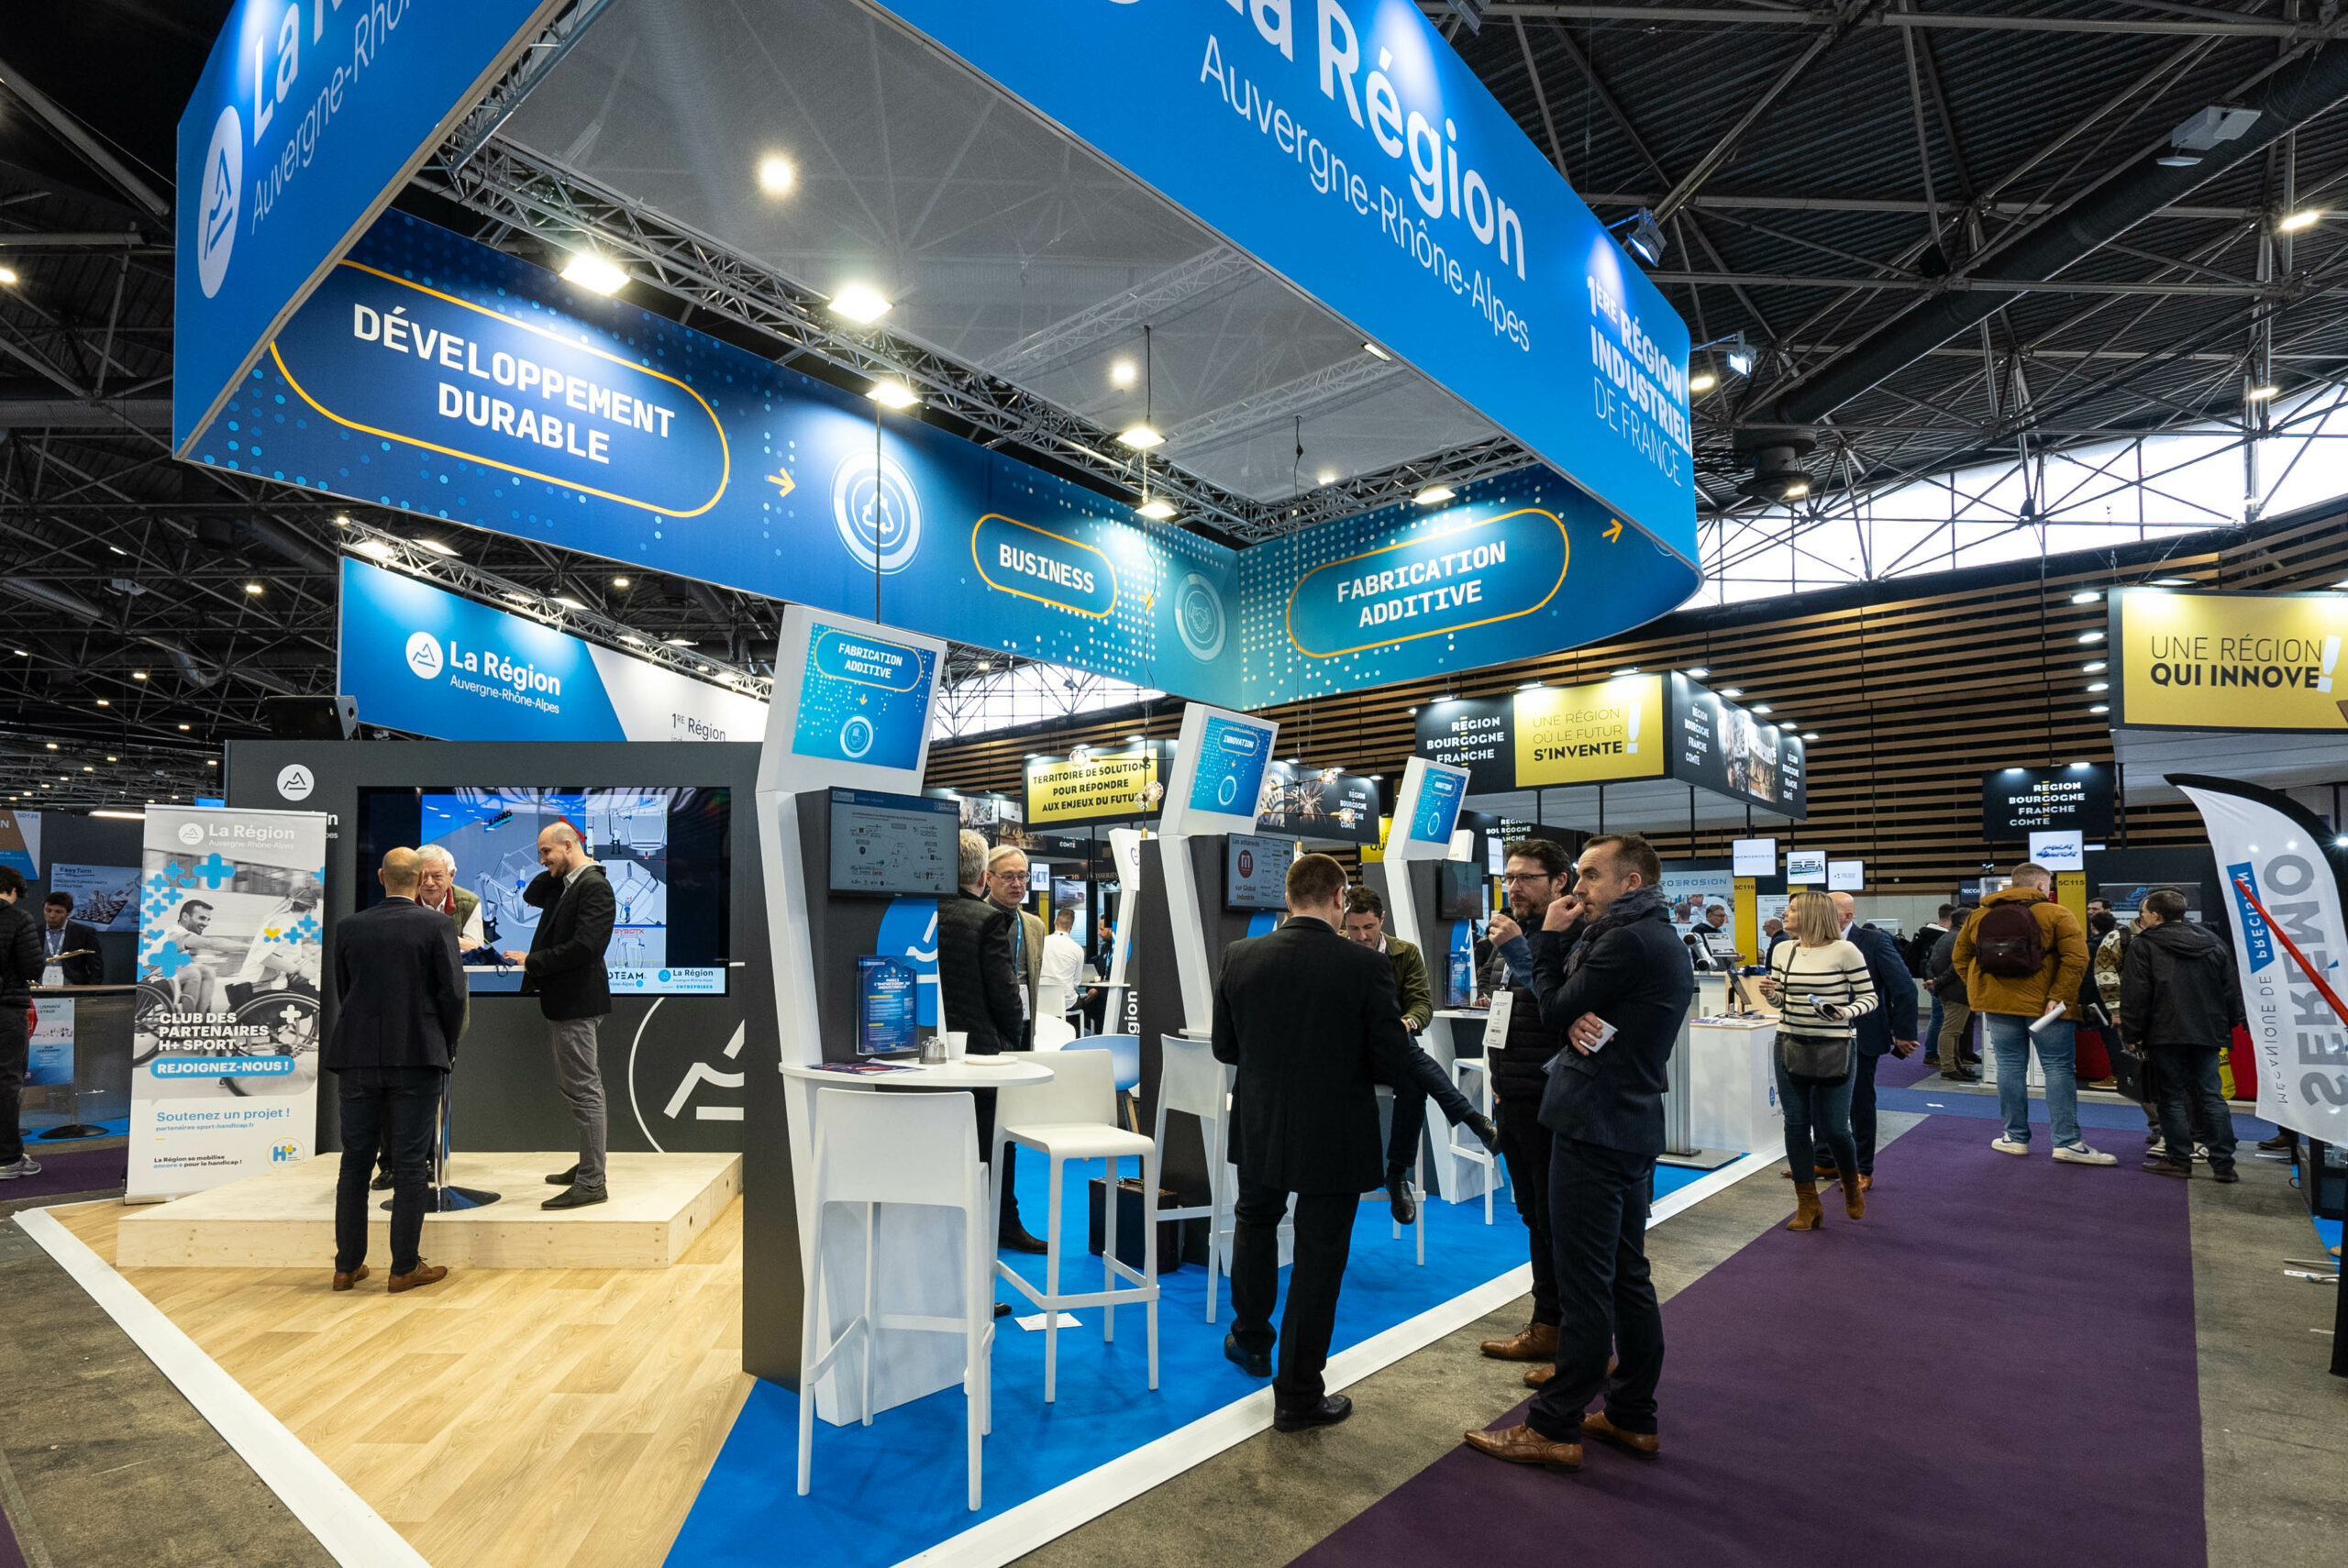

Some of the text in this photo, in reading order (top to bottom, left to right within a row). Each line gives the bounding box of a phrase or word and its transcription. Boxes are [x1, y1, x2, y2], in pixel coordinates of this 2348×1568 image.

[254, 2, 299, 148] La
[251, 0, 410, 235] Auvergne-Rhô
[1225, 0, 1526, 281] a Région
[1200, 34, 1531, 353] Auvergne-Rhône-Alpes
[1620, 308, 1683, 406] RÉGION
[353, 304, 675, 437] DÉVELOPPEMENT
[437, 382, 610, 464] DURABLE
[1594, 376, 1682, 487] DE FRANCE
[999, 543, 1095, 593] BUSINESS
[1336, 540, 1507, 602] FABRICATION
[1358, 580, 1483, 628] ADDITIVE
[838, 643, 903, 667] FABRICATION
[2151, 635, 2321, 662] UNE RÉGION
[449, 641, 560, 696] La Région
[845, 659, 892, 679] ADDITIVE
[2151, 663, 2202, 688] QUI
[2210, 665, 2320, 689] INNOVE
[449, 675, 559, 714] Auvergne-Rhône-Alpes
[1533, 707, 1620, 728] UNE RÉGION
[1684, 718, 1710, 738] BOURGOGNE
[688, 717, 726, 742] Région
[1534, 725, 1623, 744] OÙ LE FUTUR
[1223, 734, 1255, 748] INNOVATION
[1426, 731, 1505, 750] BOURGOGNE
[1688, 736, 1708, 753] FRANCHE
[1436, 748, 1495, 764] FRANCHE
[1534, 741, 1623, 762] S'INVENTE
[1033, 762, 1152, 784] TERRITOIRE DE SOLUTIONS
[1042, 792, 1139, 812] AUX ENJEUX DU FUTU
[1053, 786, 1078, 797] POUR
[2009, 793, 2086, 804] BOURGOGNE
[1339, 800, 1368, 811] BOURGOGNE
[2019, 805, 2076, 815] FRANCHE
[208, 823, 295, 840] La Région
[685, 969, 714, 977] Région
[159, 1012, 237, 1024] CLUB DES
[1124, 991, 1140, 1034] gion
[159, 1025, 269, 1037] PARTENAIRES
[158, 1040, 180, 1051] H+
[183, 1039, 236, 1051] SPORT
[157, 1061, 282, 1074] REJOIGNEZ-NOUS
[156, 1110, 220, 1122] Soutenez
[224, 1111, 240, 1120] un
[243, 1108, 282, 1121] projet
[163, 1155, 187, 1164] Région
